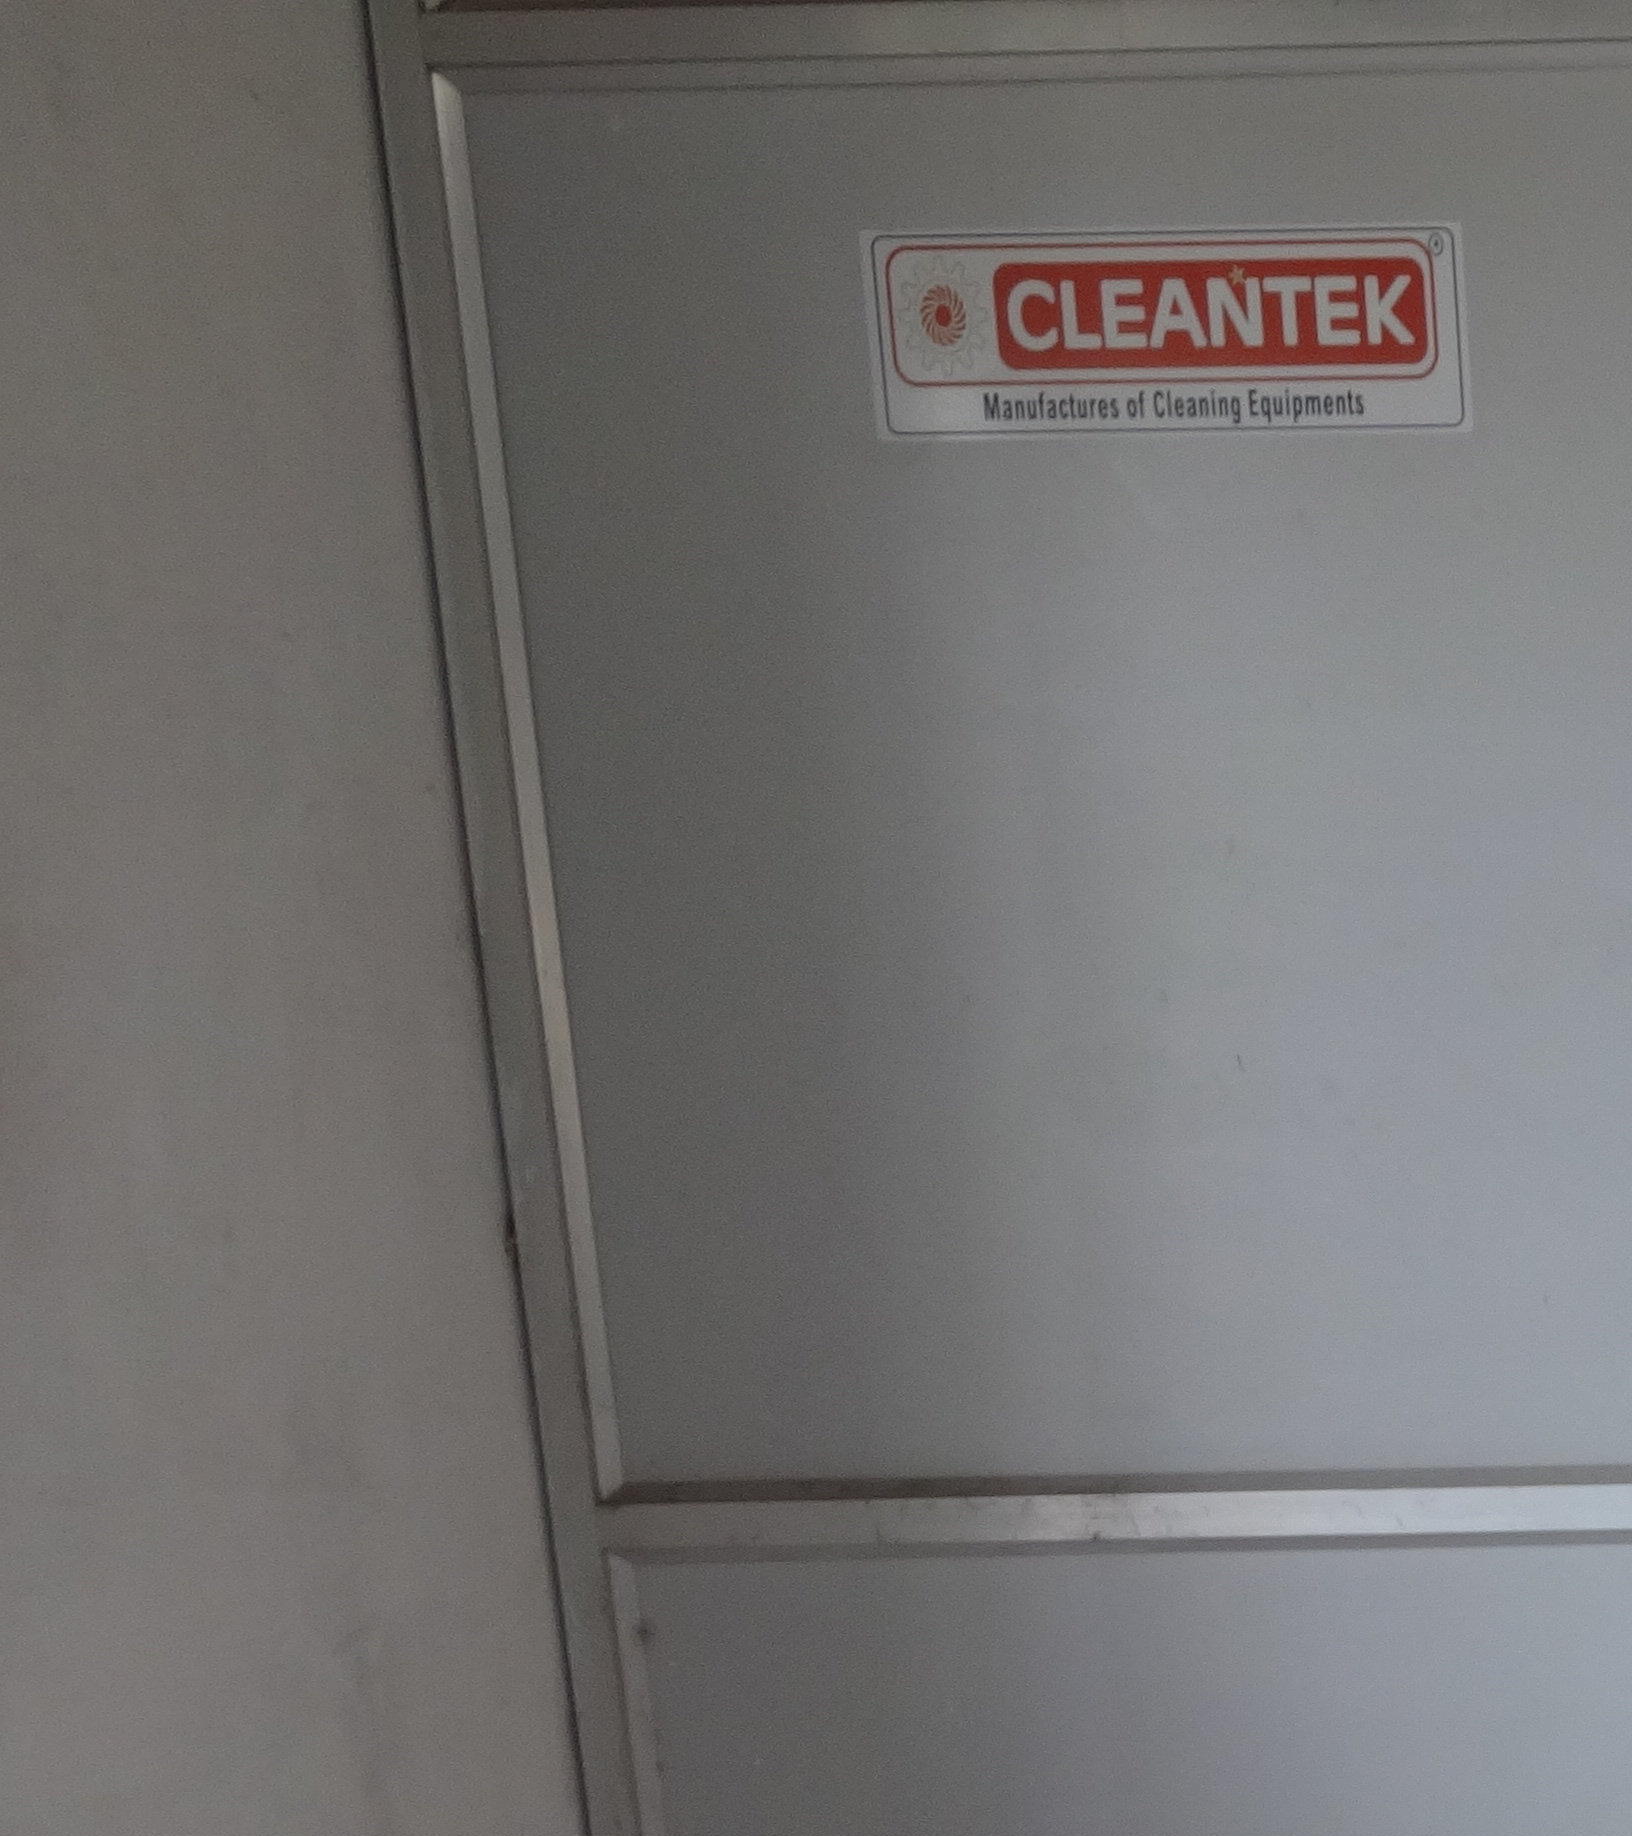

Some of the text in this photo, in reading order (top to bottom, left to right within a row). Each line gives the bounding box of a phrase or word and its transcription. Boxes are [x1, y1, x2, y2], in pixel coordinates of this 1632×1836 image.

[1007, 275, 1416, 352] CLEANTEK
[983, 388, 1365, 424] Manufactures of Cleaning Equipments
